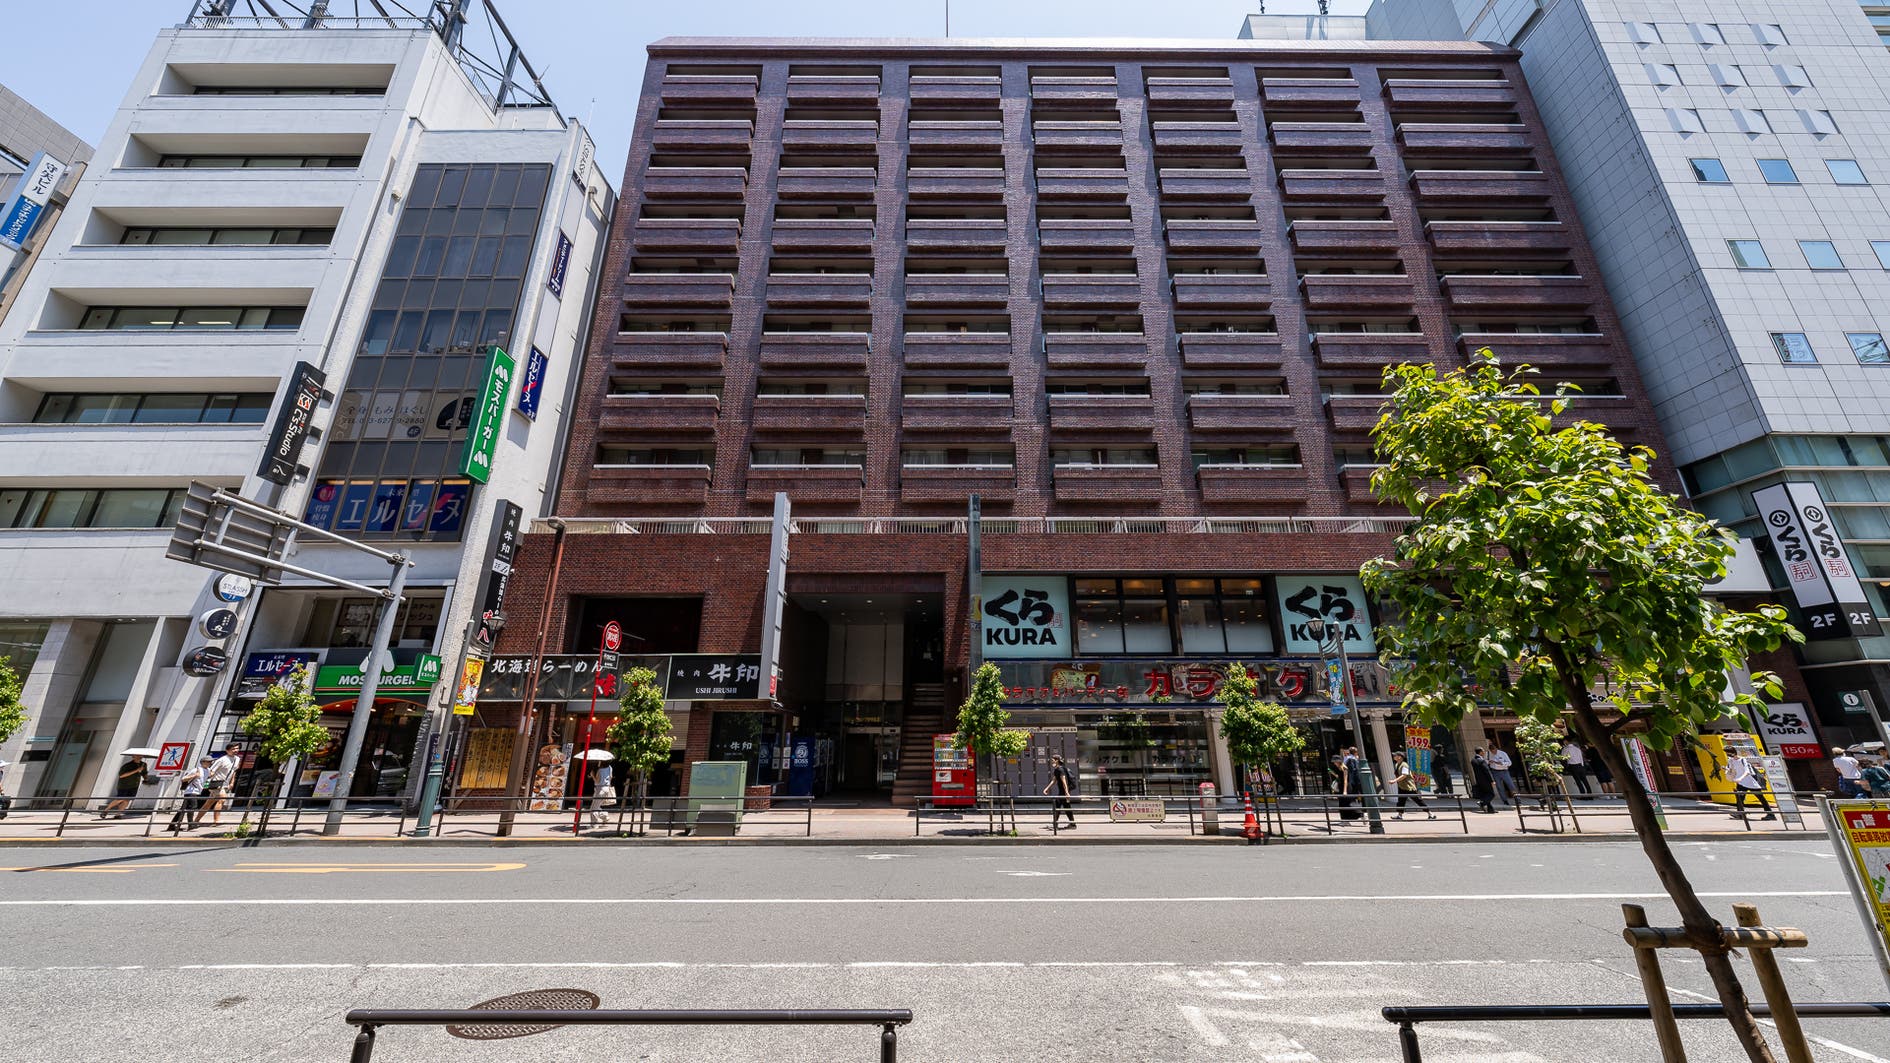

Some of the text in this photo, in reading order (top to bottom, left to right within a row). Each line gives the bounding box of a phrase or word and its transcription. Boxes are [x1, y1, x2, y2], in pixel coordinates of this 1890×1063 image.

[522, 350, 540, 403] エルセーヌ
[482, 379, 503, 450] モスバーガー
[342, 500, 464, 524] エルセーヌ
[1777, 526, 1807, 562] くら
[1811, 523, 1840, 559] くら
[984, 589, 1054, 626] くら
[1285, 586, 1355, 621] くら
[1811, 613, 1836, 628] 2F
[1849, 613, 1871, 625] 2F
[986, 628, 1057, 645] KURA
[1290, 624, 1361, 641] KRA
[491, 659, 603, 673] 北海道らーめん
[707, 663, 759, 683] 牛印
[1767, 727, 1807, 735] KURA
[730, 741, 752, 750] 牛印
